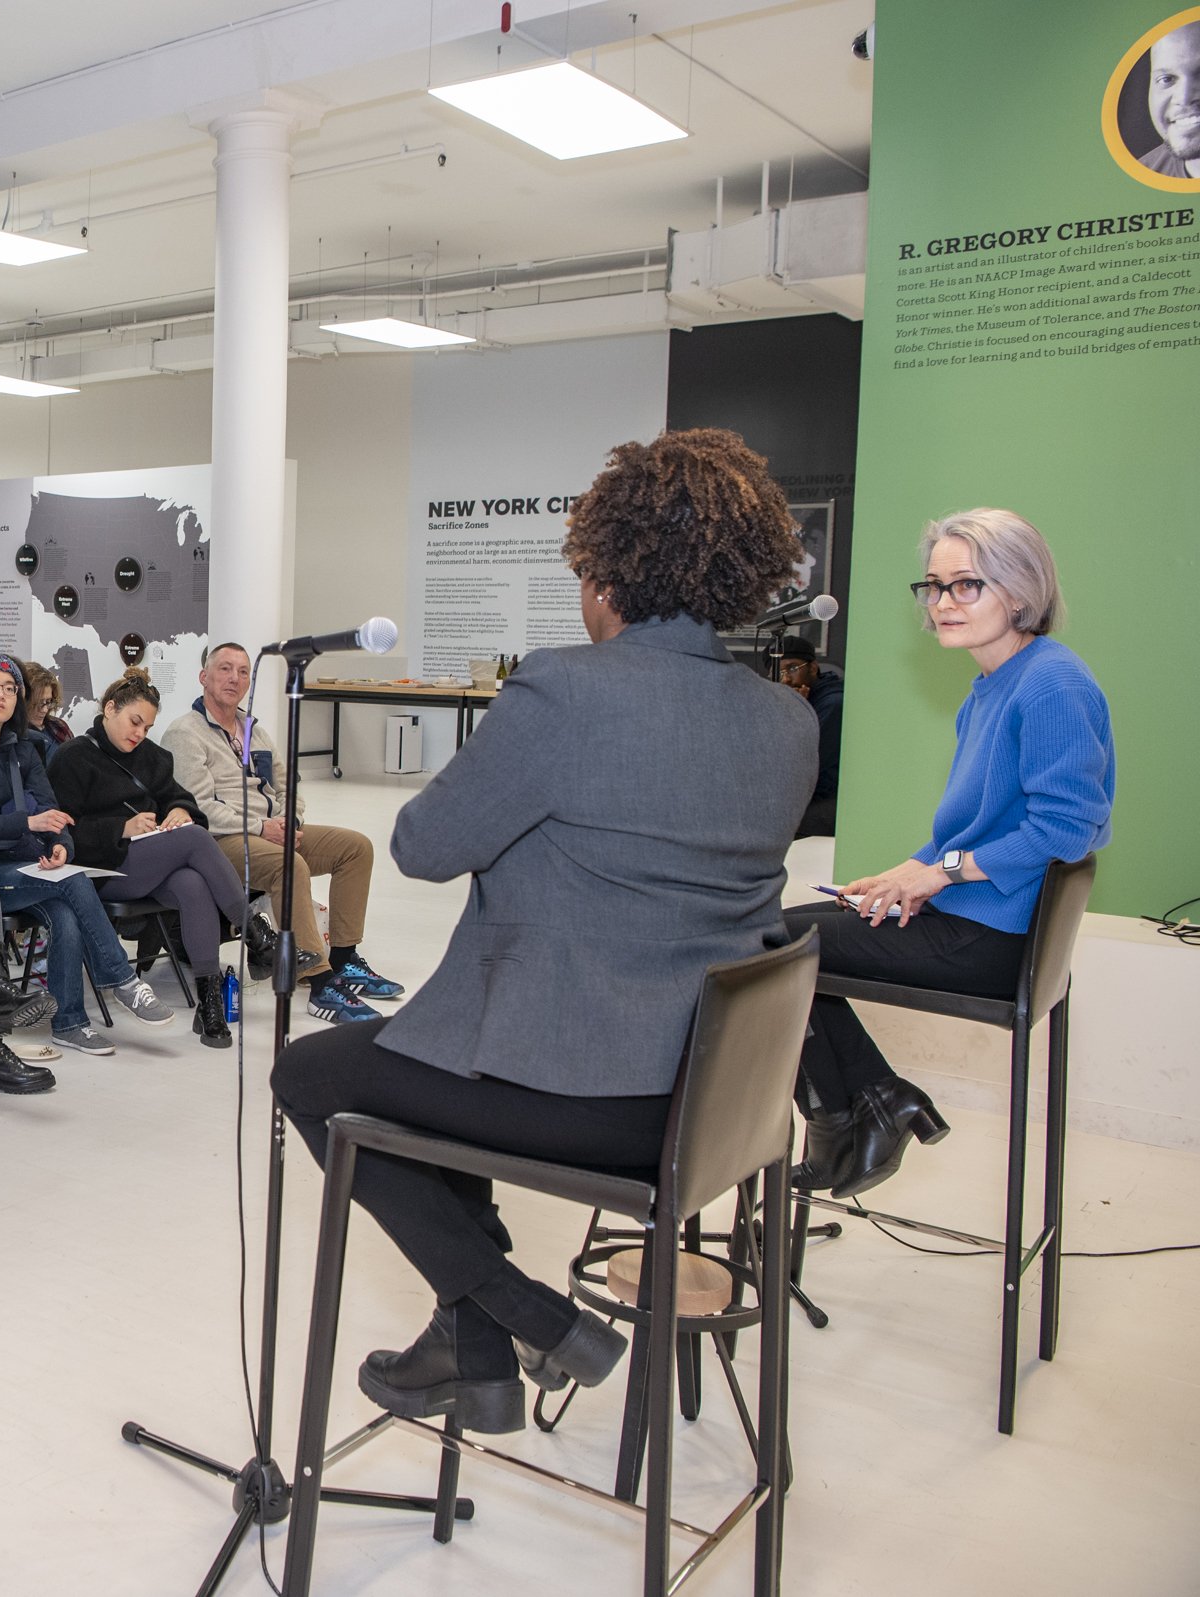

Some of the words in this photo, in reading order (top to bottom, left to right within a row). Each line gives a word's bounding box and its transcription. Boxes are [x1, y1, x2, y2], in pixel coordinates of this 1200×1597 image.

[899, 243, 921, 260] R.
[927, 226, 1051, 256] GREGORY
[1057, 208, 1194, 240] CHRISTIE
[898, 267, 907, 276] is
[909, 267, 922, 275] an
[925, 263, 954, 274] artist
[957, 258, 978, 270] and
[980, 258, 994, 267] an
[998, 251, 1057, 265] illustrator
[1060, 247, 1072, 258] of
[1073, 241, 1133, 256] children's
[1137, 236, 1173, 248] books
[1175, 232, 1200, 245] and
[896, 296, 936, 308] Coretta
[938, 293, 966, 303] Scott
[969, 290, 996, 300] King
[998, 286, 1034, 296] Honor
[1037, 279, 1094, 293] recipient,
[1097, 275, 1120, 287] and
[1122, 276, 1129, 284] a
[1132, 269, 1192, 283] Caldecott
[897, 282, 927, 292] more.
[930, 279, 944, 289] He
[947, 277, 956, 286] is
[958, 276, 972, 284] an
[976, 270, 1018, 283] NAACP
[1020, 266, 1056, 278] Image
[1058, 261, 1096, 274] Award
[1099, 257, 1146, 270] winner,
[1148, 256, 1155, 264] a
[896, 312, 930, 323] Honor
[933, 307, 973, 319] winner.
[977, 304, 1000, 315] He's
[1003, 303, 1027, 311] won
[1030, 295, 1090, 309] additional
[1093, 290, 1136, 304] awards
[1139, 289, 1169, 299] from
[1173, 286, 1196, 296] The
[896, 329, 918, 339] York
[920, 325, 954, 336] Times,
[956, 322, 975, 333] the
[977, 319, 1026, 331] Museum
[1029, 315, 1041, 326] of
[1043, 313, 1104, 325] Tolerance,
[1107, 307, 1130, 319] and
[1133, 305, 1156, 316] The
[1158, 303, 1200, 315] Boston
[894, 343, 924, 354] Globe.
[927, 339, 972, 351] Christie
[974, 336, 984, 347] is
[987, 333, 1030, 346] focused
[1032, 333, 1047, 342] on
[1050, 325, 1125, 341] encouraging
[1127, 321, 1191, 335] audiences
[1193, 320, 1200, 329] t
[893, 359, 916, 370] find
[918, 360, 924, 368] a
[926, 356, 949, 367] love
[951, 354, 968, 365] for
[969, 350, 1017, 363] learning
[1019, 348, 1041, 360] and
[1044, 347, 1056, 357] to
[1058, 344, 1089, 356] build
[1091, 340, 1136, 354] bridges
[1138, 339, 1152, 350] of
[781, 474, 845, 486] EDLINING
[428, 500, 476, 518] NEW
[481, 497, 540, 516] YORK
[428, 521, 463, 530] Sacrifice
[465, 521, 489, 529] Zones
[426, 549, 468, 557] neighborhood
[538, 547, 561, 555] region,
[486, 539, 519, 548] geographic
